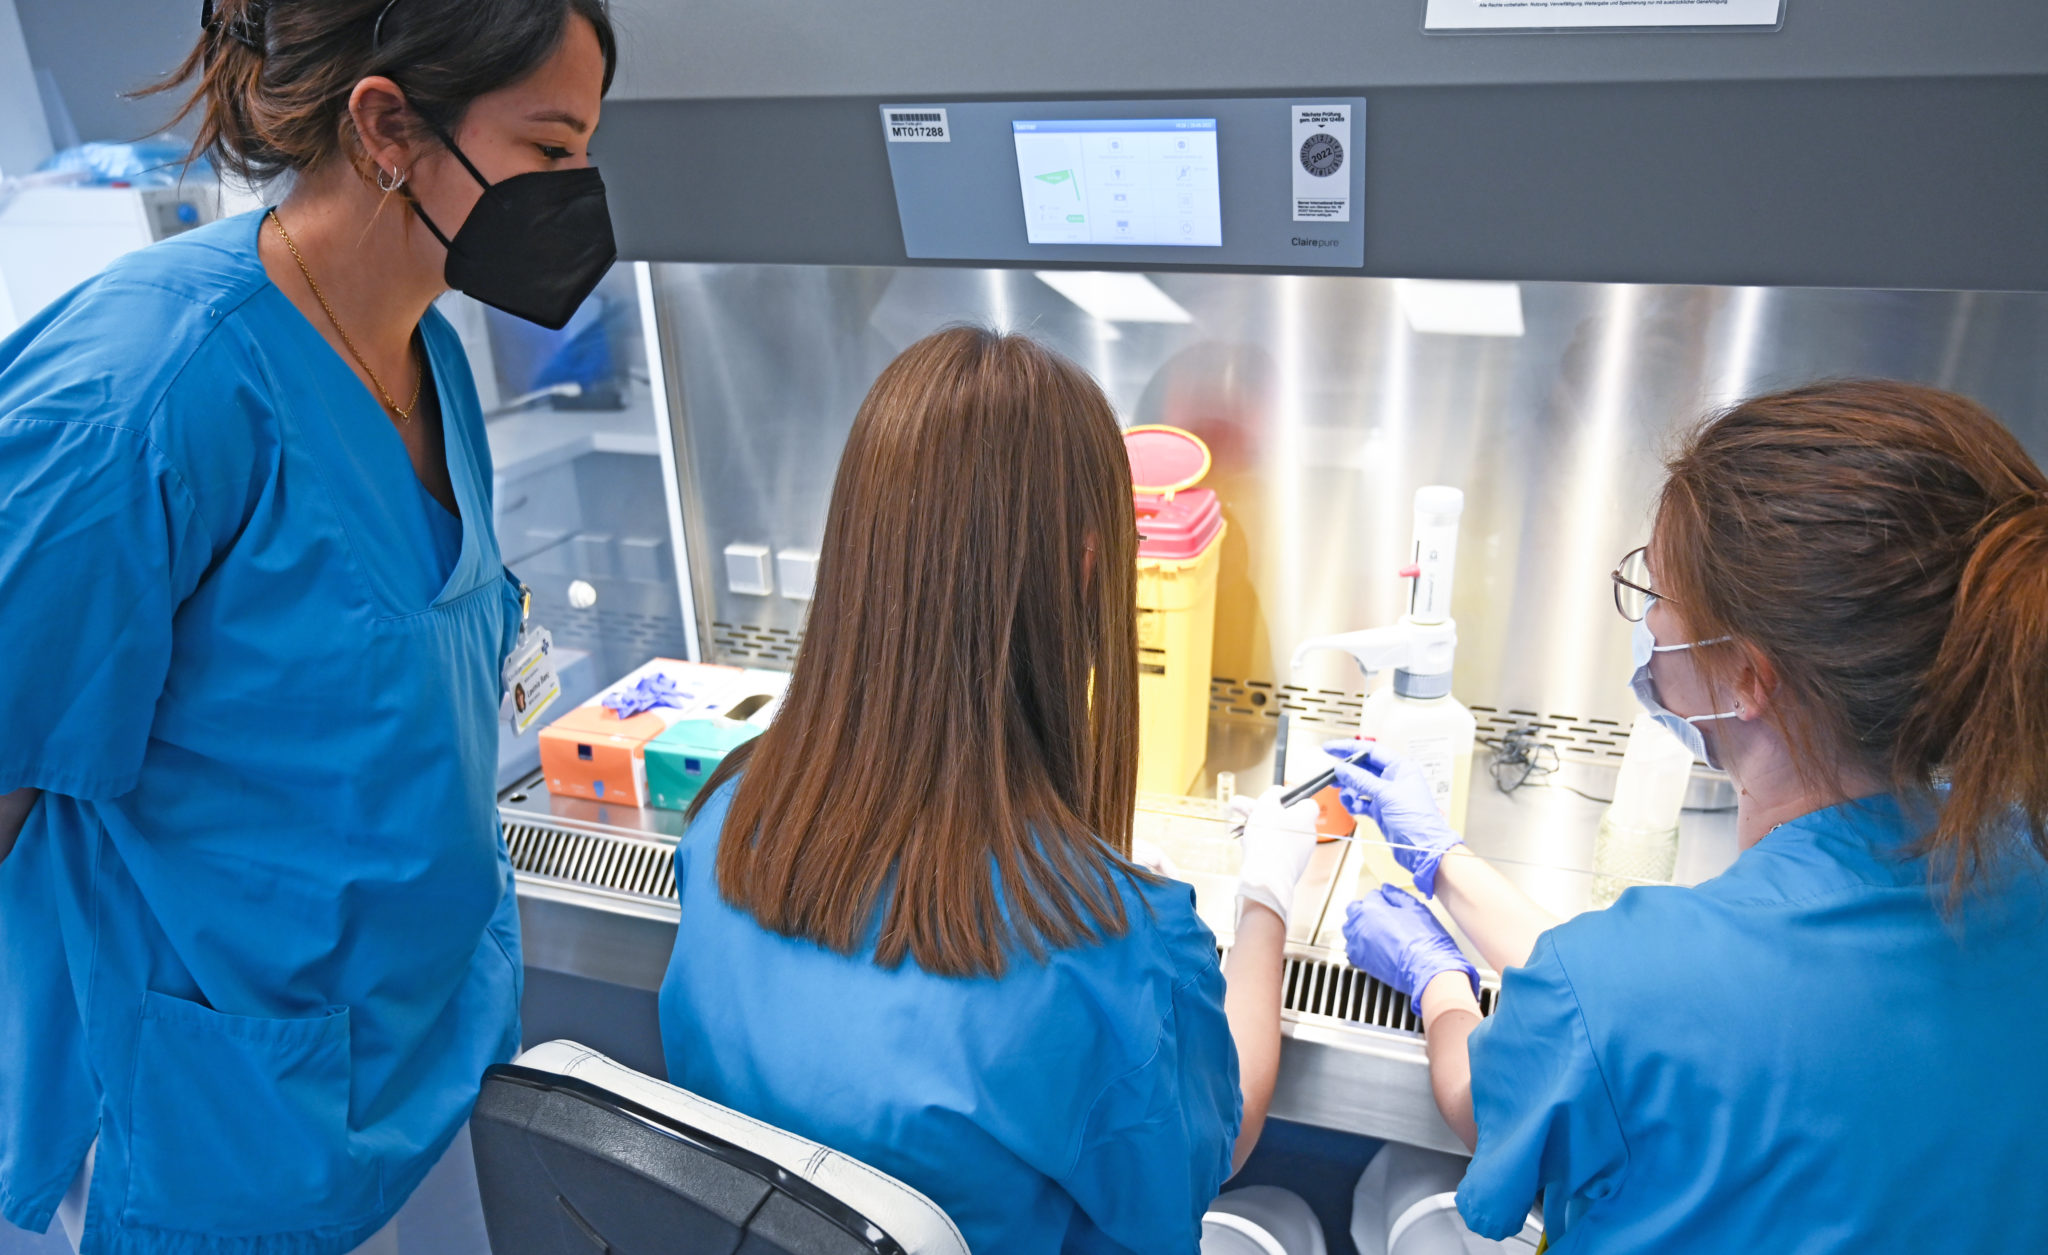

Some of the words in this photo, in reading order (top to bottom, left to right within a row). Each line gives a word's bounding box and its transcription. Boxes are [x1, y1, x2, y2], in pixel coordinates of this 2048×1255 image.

[1322, 111, 1341, 119] Prüfung
[892, 127, 944, 137] MT017288
[1312, 147, 1333, 163] 2022
